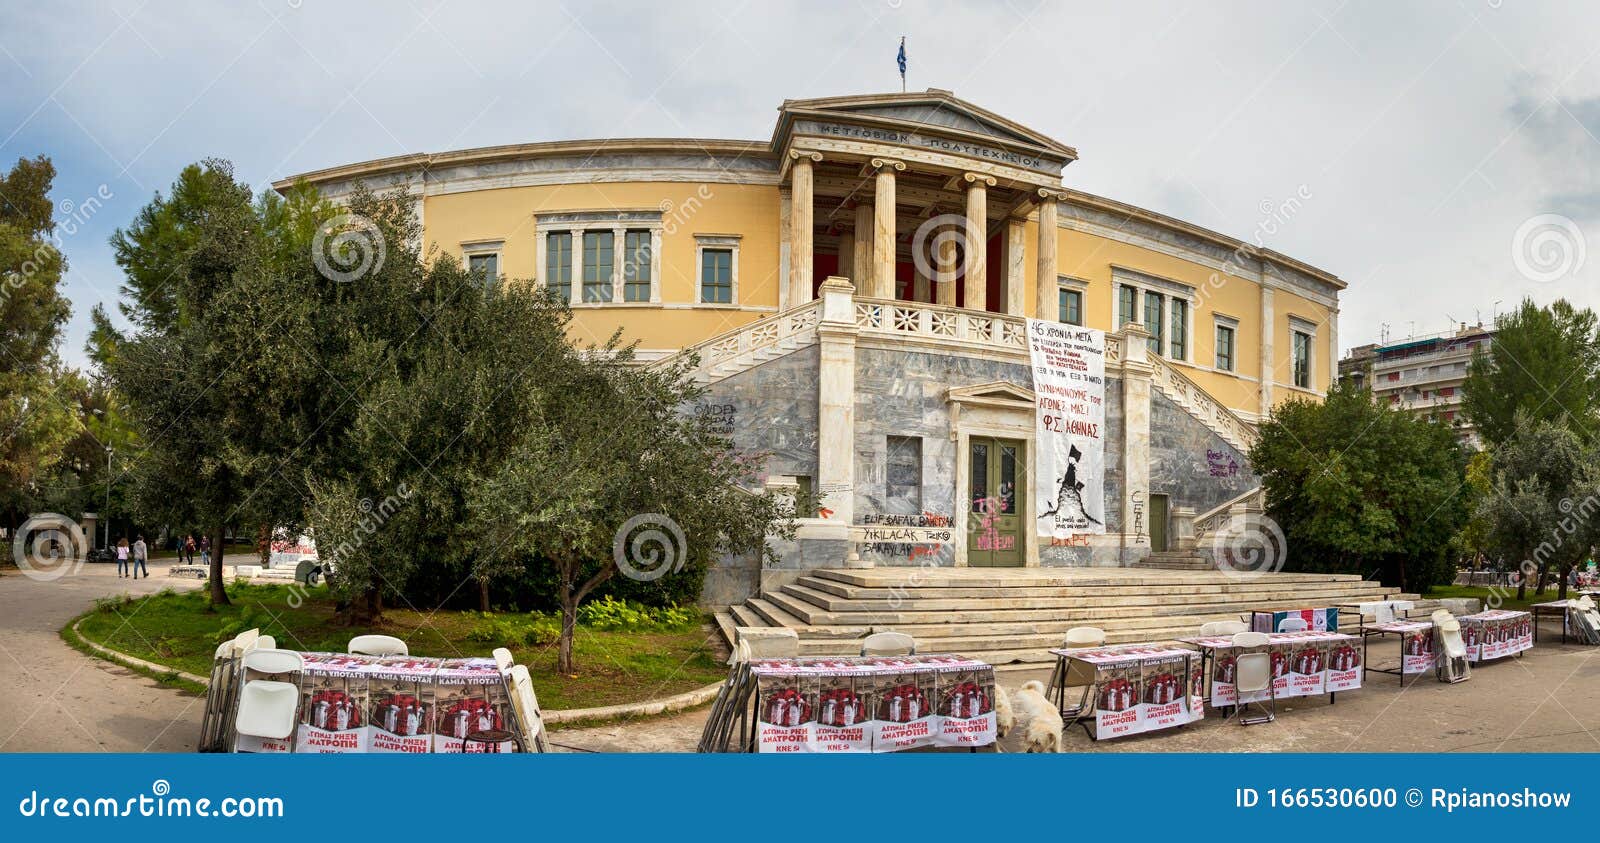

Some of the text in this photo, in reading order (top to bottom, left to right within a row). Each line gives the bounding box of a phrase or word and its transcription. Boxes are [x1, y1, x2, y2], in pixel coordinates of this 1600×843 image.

[930, 139, 1041, 168] ΠΟΛΥΤΕΧΝΕΙΟΝ
[1032, 322, 1092, 343] 46 ΧΡΟΝΙΑ ΜΕΤΑ
[1088, 375, 1102, 385] ΝΑΤΟ
[1039, 398, 1065, 412] ΑΓΩΝΕΣ
[1066, 420, 1099, 439] ΑΘΗΝΑΣ
[372, 672, 399, 681] ΚΑΜΙΑ
[439, 677, 465, 685] ΚΑΜΙΑ
[403, 738, 427, 746] ΡΗΞΗ
